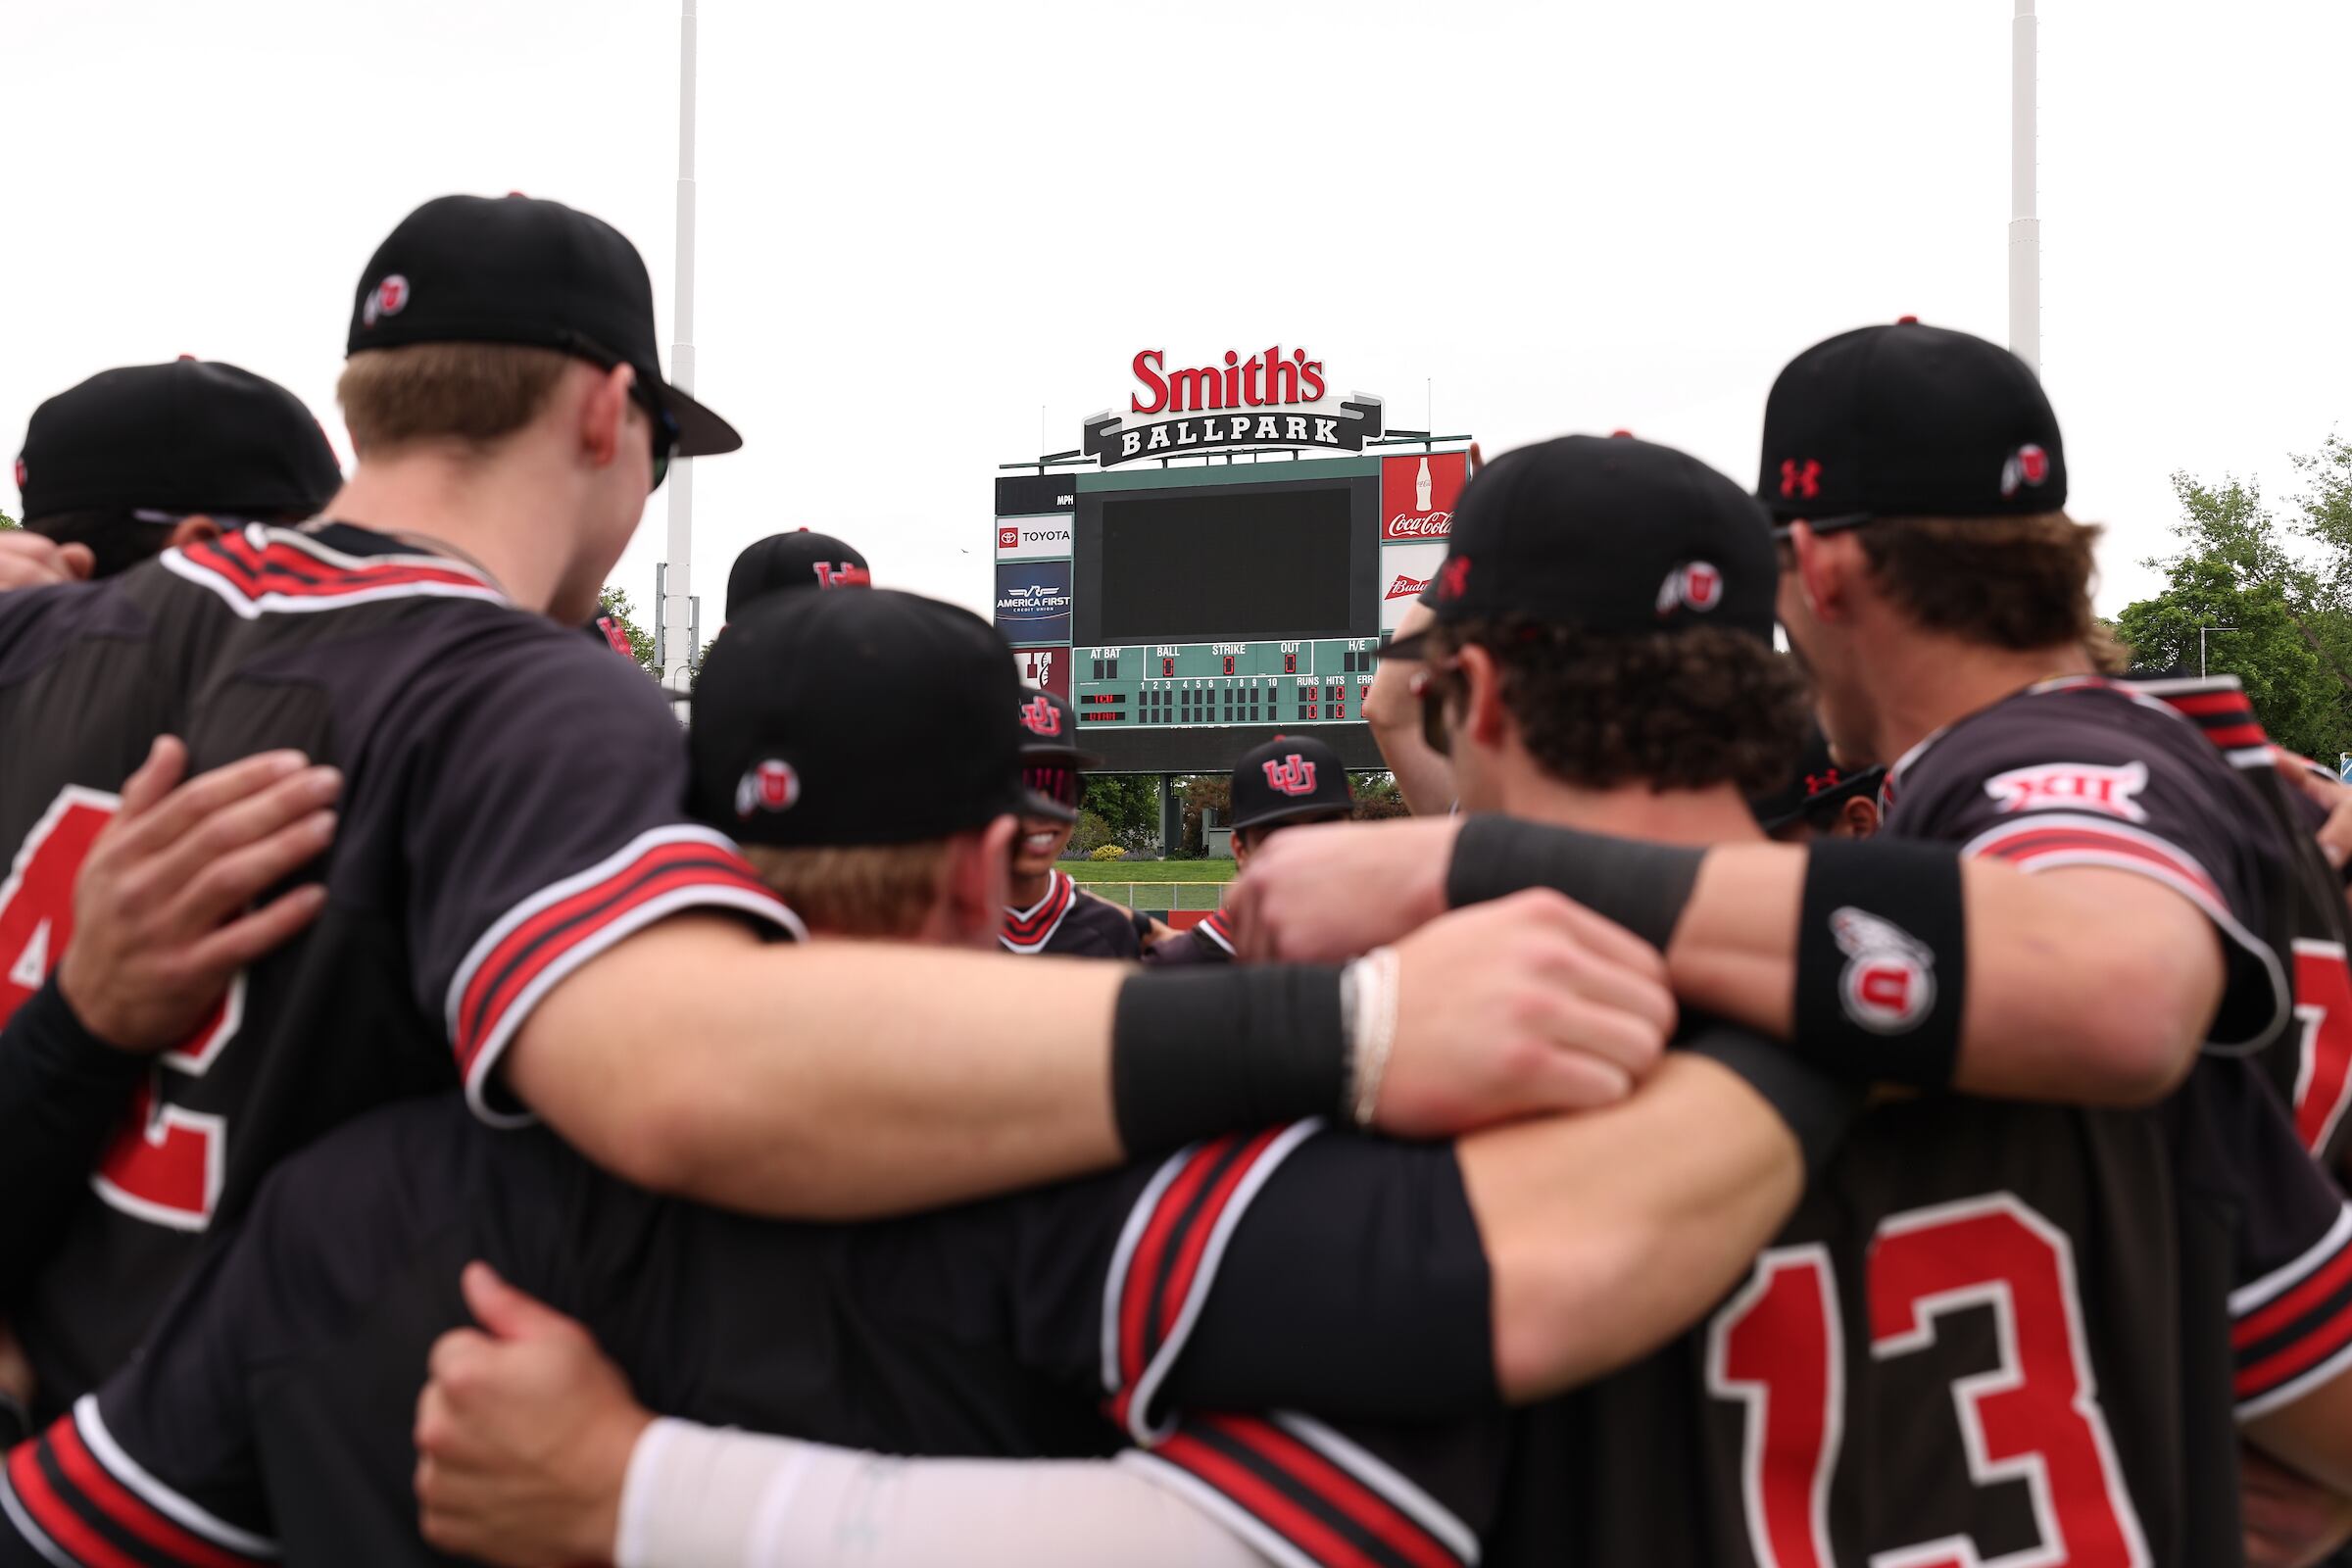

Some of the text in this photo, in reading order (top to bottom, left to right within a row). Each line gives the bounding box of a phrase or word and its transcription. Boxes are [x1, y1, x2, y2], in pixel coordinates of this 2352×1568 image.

[1132, 346, 1325, 414] Smith's
[1121, 416, 1339, 458] BALLPARK
[1056, 495, 1074, 506] MPH
[1388, 512, 1455, 537] Coca-Cola
[1022, 531, 1071, 542] TOYOTA
[997, 596, 1071, 609] AMERICA FIRST
[1156, 646, 1181, 657] BALL
[1212, 644, 1246, 656] STRIKE
[1280, 642, 1300, 654] OUT
[1348, 640, 1366, 652] H/E
[1090, 648, 1121, 660] AT BAT
[1163, 658, 1174, 676] 0
[1223, 656, 1235, 675] 0
[1285, 654, 1297, 673] 0
[1182, 680, 1188, 689] 4
[1208, 679, 1214, 688] 6
[1239, 678, 1245, 687] 8
[1297, 676, 1320, 686] RUNS
[1326, 675, 1346, 685] HITS
[1356, 674, 1374, 684] ERR
[1308, 686, 1317, 702] 0
[1336, 685, 1345, 701] 0
[1308, 705, 1317, 719] 0
[1336, 704, 1345, 718] 0
[1705, 1191, 2154, 1568] 13
